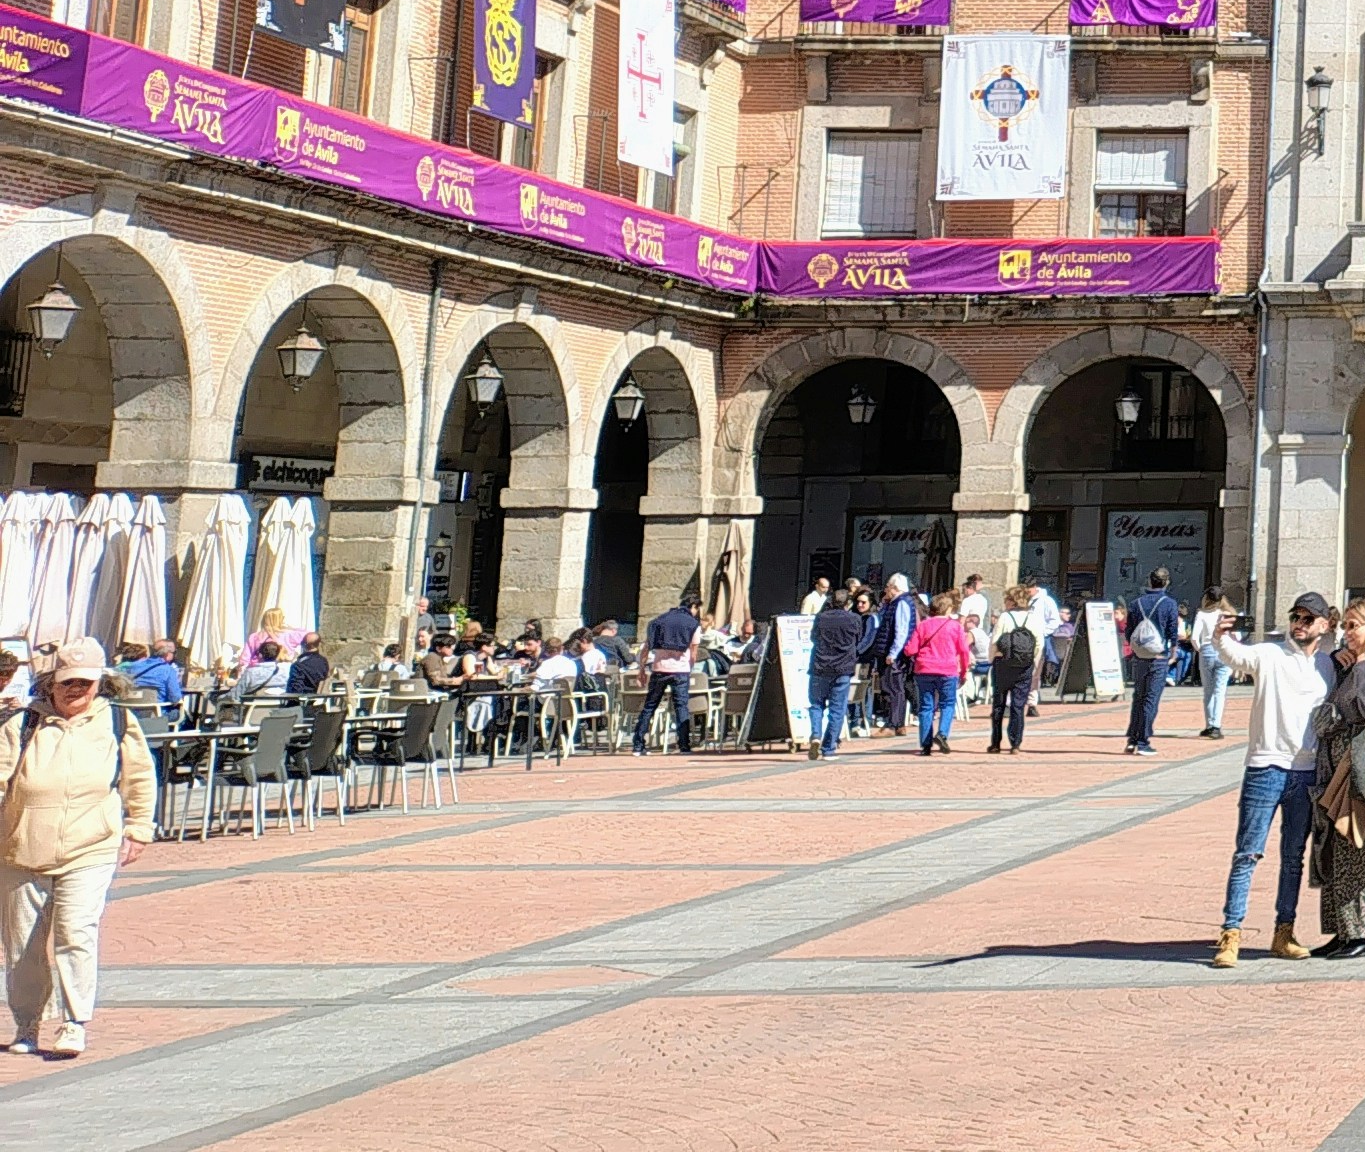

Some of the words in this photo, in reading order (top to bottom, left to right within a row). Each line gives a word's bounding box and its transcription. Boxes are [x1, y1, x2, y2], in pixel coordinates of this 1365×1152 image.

[171, 96, 226, 145] ÁVILA
[302, 117, 366, 152] Ayuntamiento
[301, 139, 313, 157] de
[314, 141, 339, 165] Ávila
[972, 150, 1033, 171] ÁVILA
[539, 190, 586, 216] Ayuntamiento
[842, 257, 879, 266] SEMANA
[880, 257, 911, 267] SANTA
[1036, 265, 1054, 279] de
[1057, 262, 1092, 279] Ávila
[1038, 250, 1132, 267] Ayuntamiento
[841, 264, 912, 291] ÁVILA
[858, 515, 930, 545] Yema
[1113, 514, 1202, 540] Yemas
